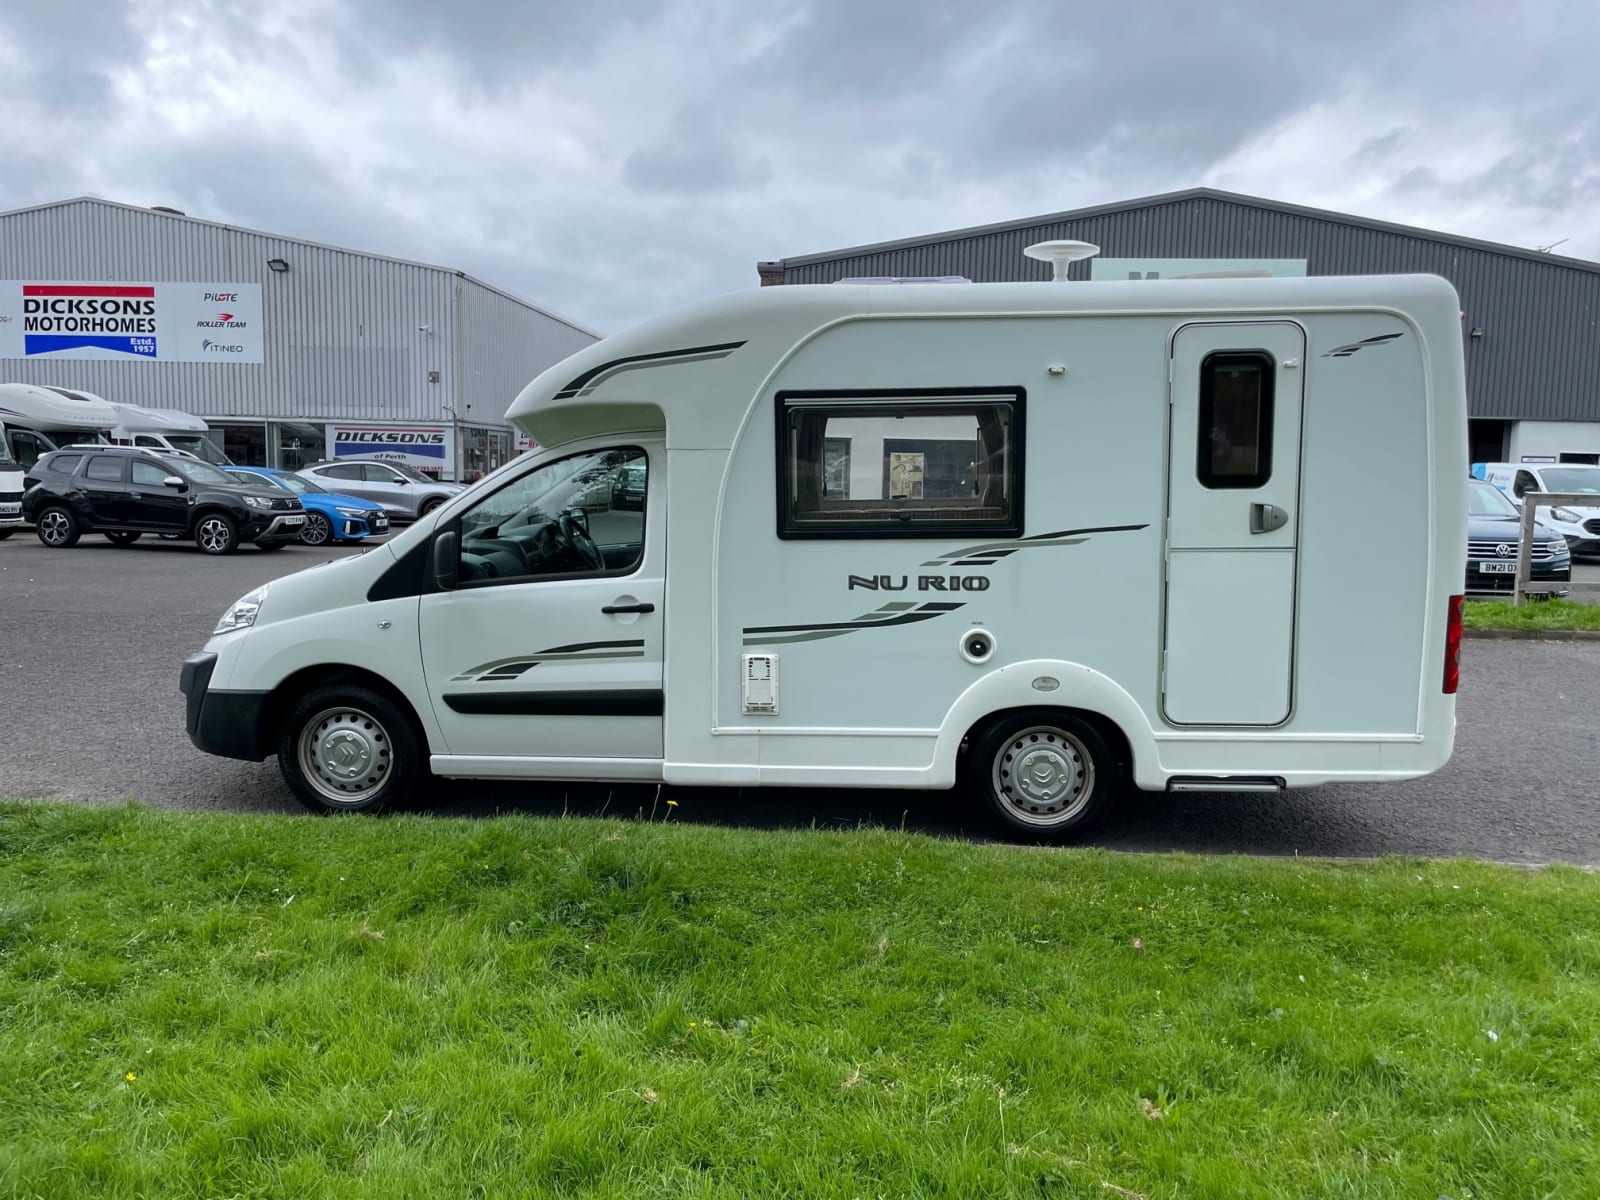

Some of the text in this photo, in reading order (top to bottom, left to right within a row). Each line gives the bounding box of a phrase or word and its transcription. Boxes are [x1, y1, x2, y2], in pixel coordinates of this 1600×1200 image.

[24, 299, 155, 315] DICKSONS
[24, 317, 156, 333] MOTORHOMES
[335, 431, 445, 444] DICKSONS
[1485, 563, 1506, 572] BW21
[848, 575, 990, 591] NU RIO
